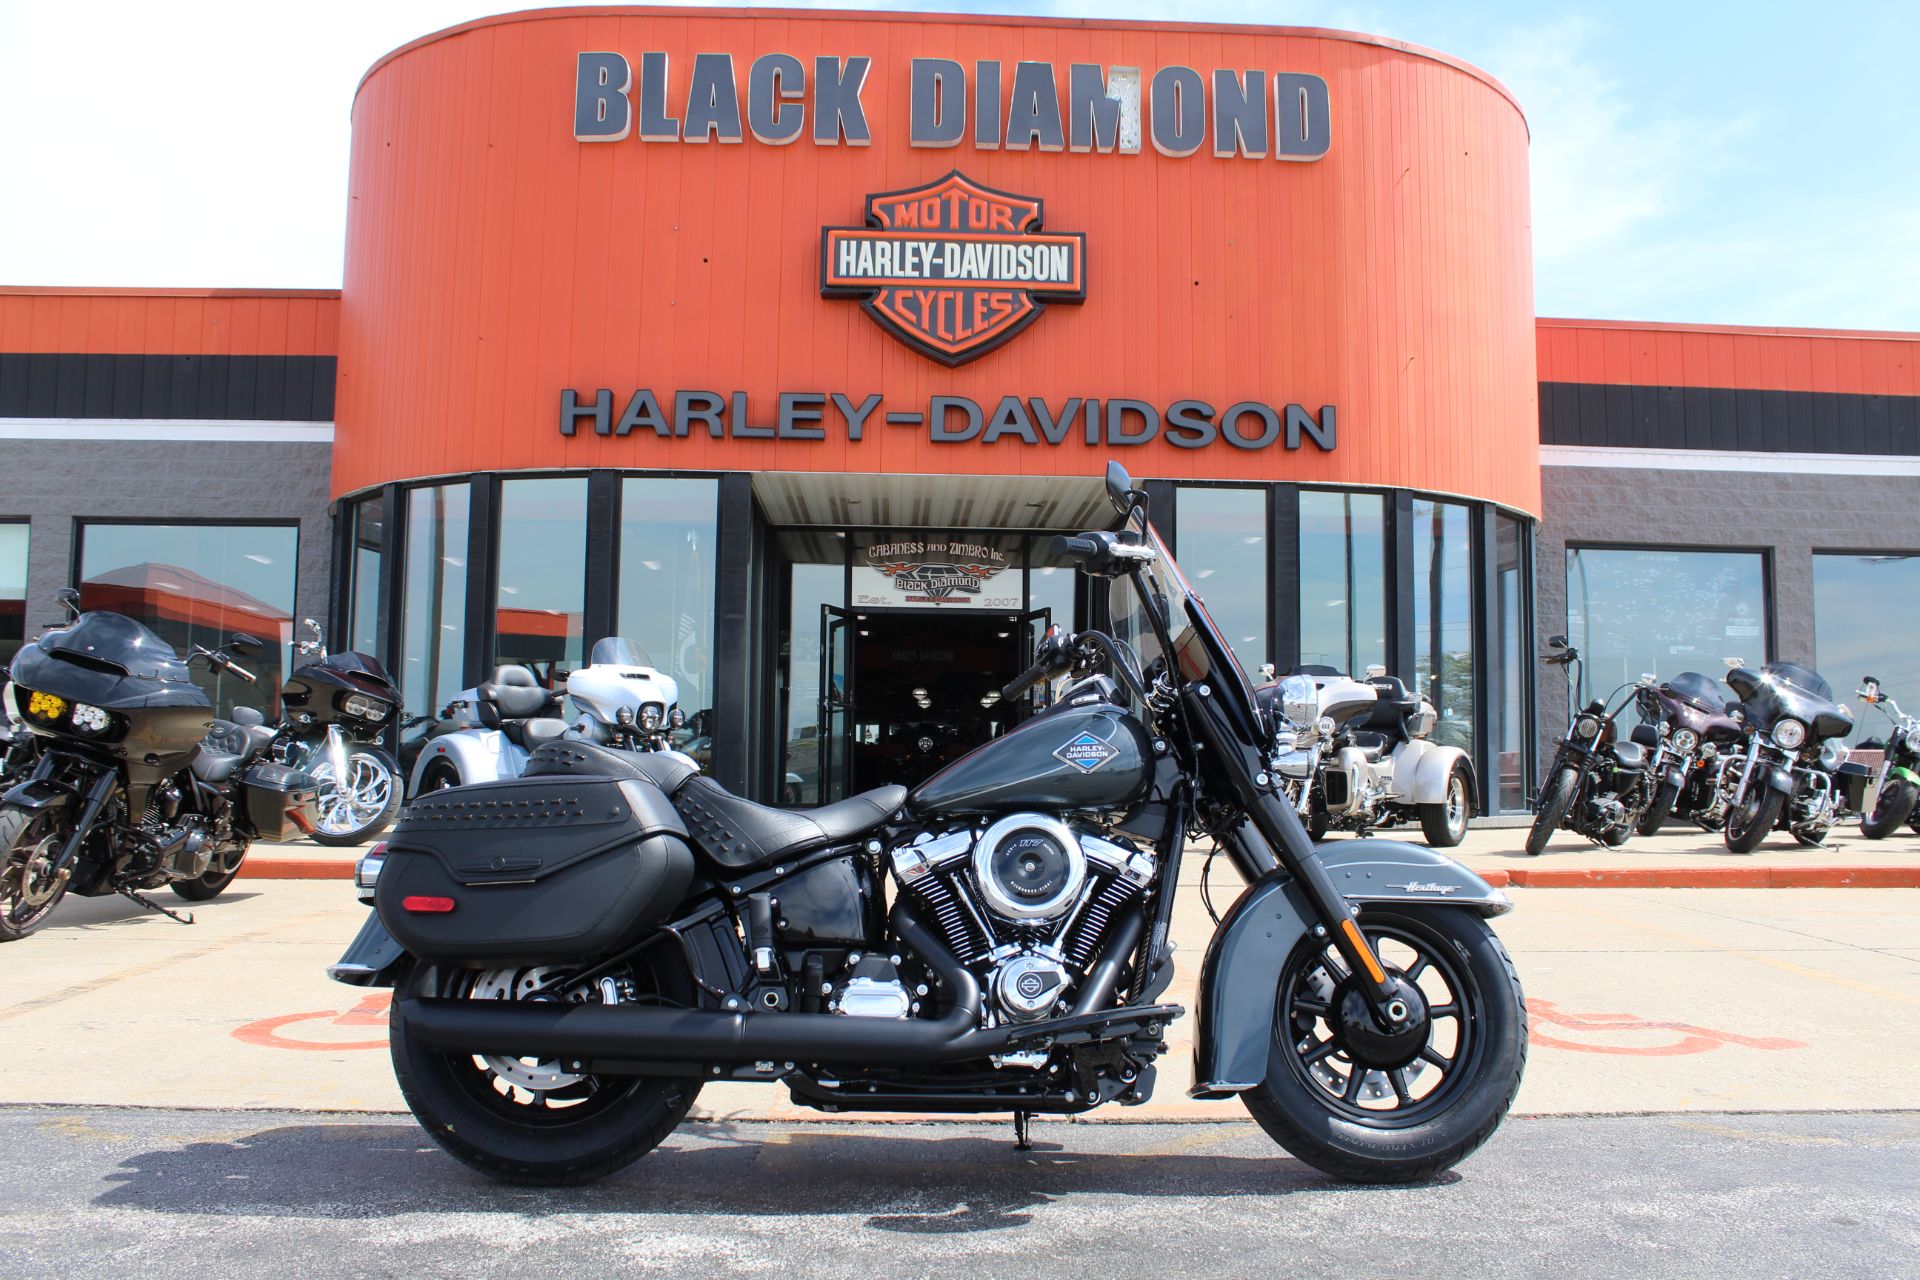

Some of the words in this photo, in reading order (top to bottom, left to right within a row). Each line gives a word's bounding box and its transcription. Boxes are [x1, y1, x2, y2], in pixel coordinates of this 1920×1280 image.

[573, 51, 873, 147] BLACK
[909, 56, 1332, 162] DIAMOND
[893, 193, 1015, 231] MOTOR
[838, 239, 1070, 283] HARLEY-DAVIDSON
[894, 290, 1013, 341] CYCLES
[558, 388, 1337, 452] HARLEY-DAVIDSON
[949, 542, 988, 558] ZIMBRO
[983, 597, 1019, 607] 2007
[1066, 750, 1108, 759] DAVIDSON
[1019, 839, 1044, 847] 117
[1405, 880, 1456, 895] Heritage
